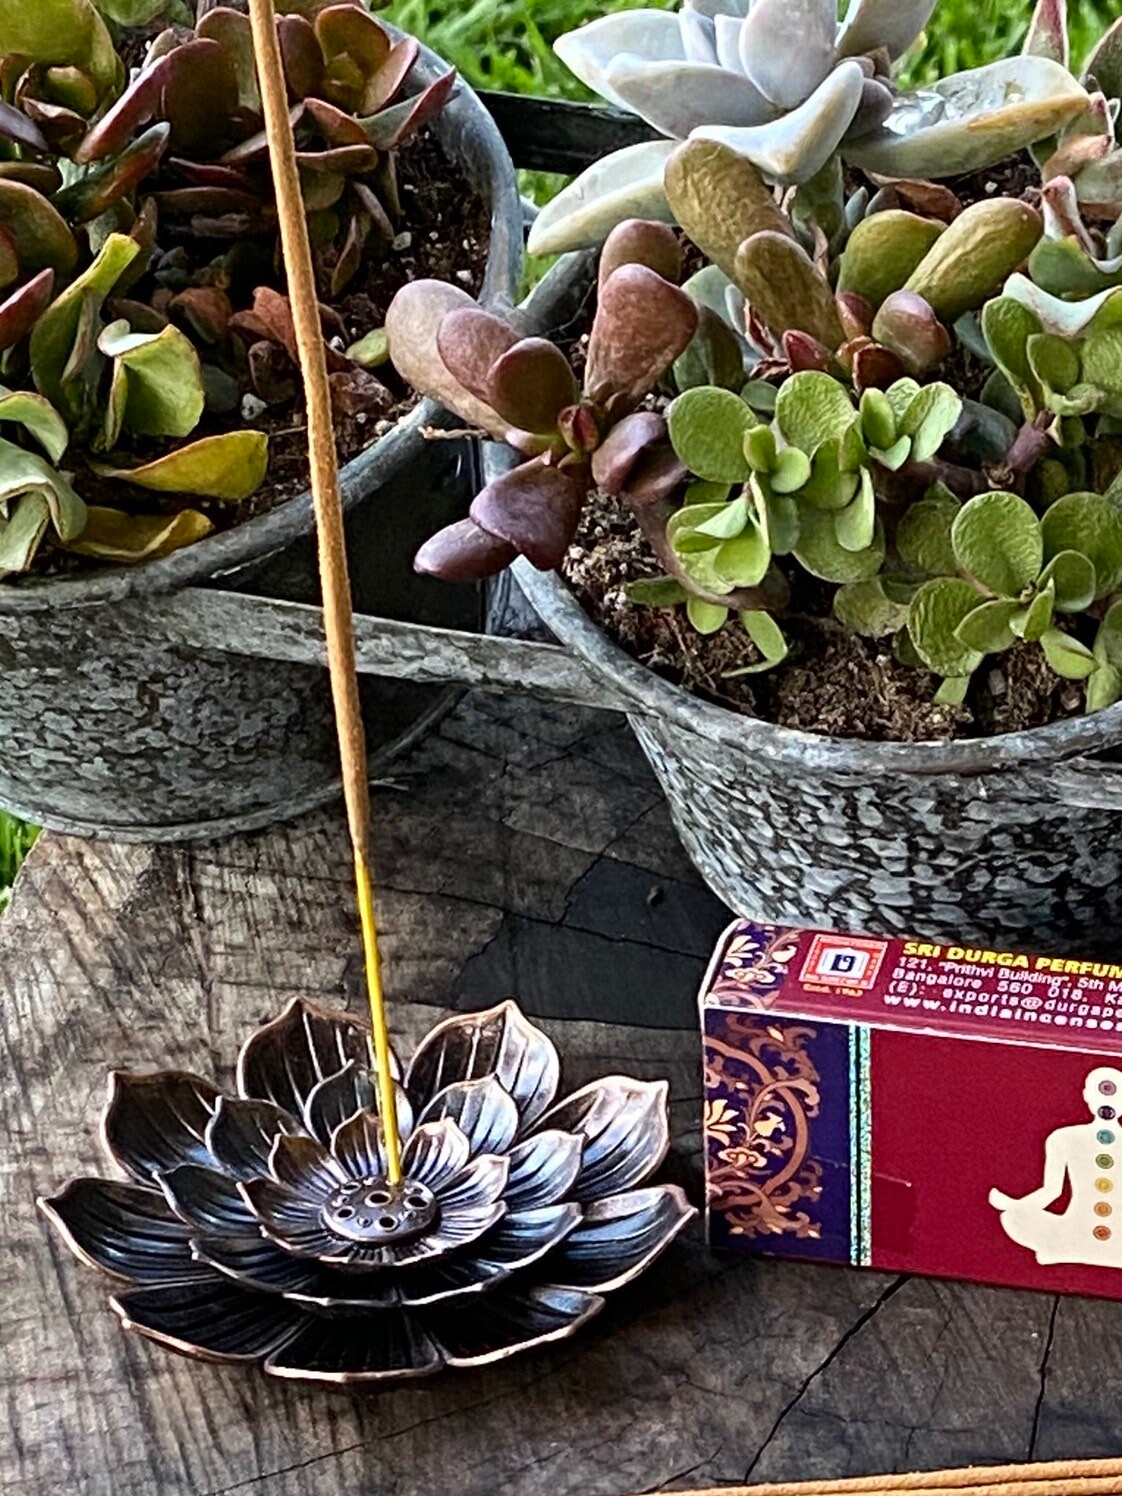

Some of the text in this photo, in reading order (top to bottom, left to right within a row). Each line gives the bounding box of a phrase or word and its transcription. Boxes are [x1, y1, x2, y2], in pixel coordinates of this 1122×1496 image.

[903, 942, 941, 958] SRI
[946, 946, 1029, 969] DURGA
[892, 968, 983, 989] Bangalore
[997, 980, 1033, 995] 560
